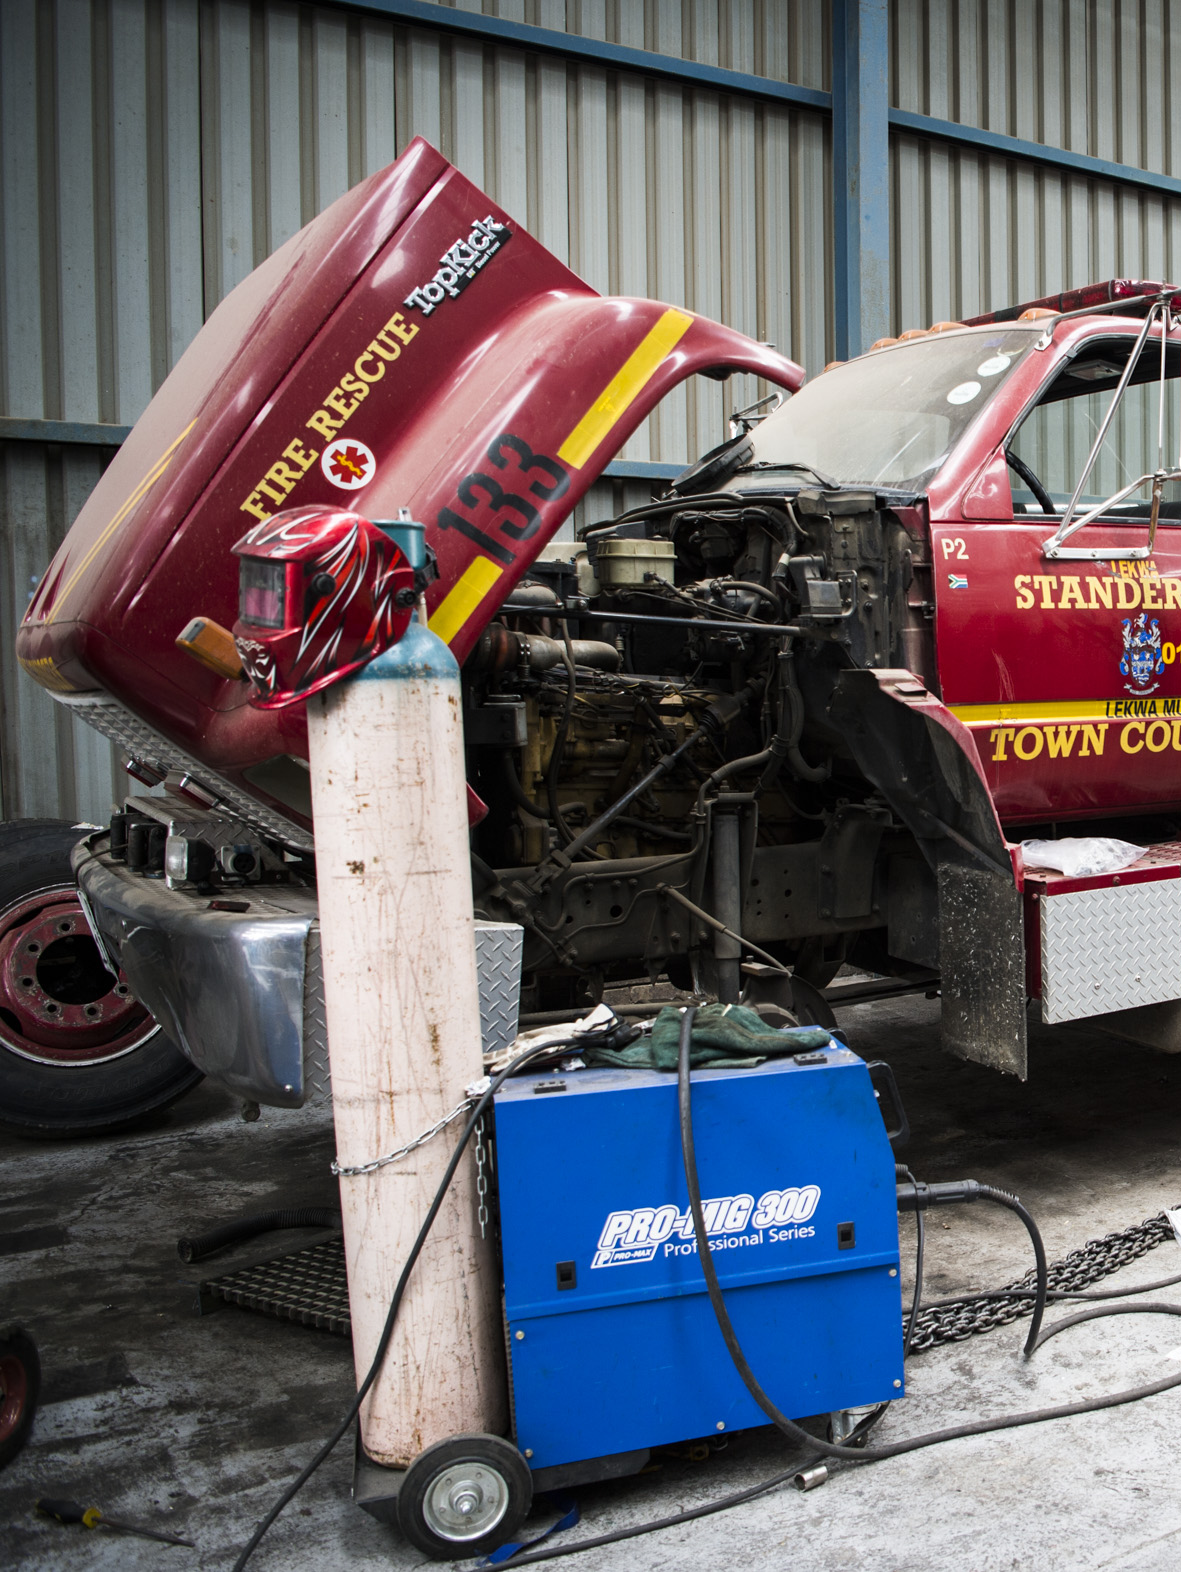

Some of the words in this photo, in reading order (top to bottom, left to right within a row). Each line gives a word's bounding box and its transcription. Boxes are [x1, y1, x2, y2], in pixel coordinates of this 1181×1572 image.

[403, 215, 506, 315] TopKick
[240, 437, 319, 523] FIRE
[306, 312, 420, 442] RESCUE
[437, 433, 571, 565] 133
[941, 538, 970, 561] P2
[1106, 700, 1159, 719] LEKWA
[990, 723, 1109, 761] TOWN
[753, 1185, 822, 1229] 300
[613, 1248, 653, 1261] PRO-MAX
[664, 1229, 764, 1257] Profssional
[769, 1225, 816, 1243] Series
